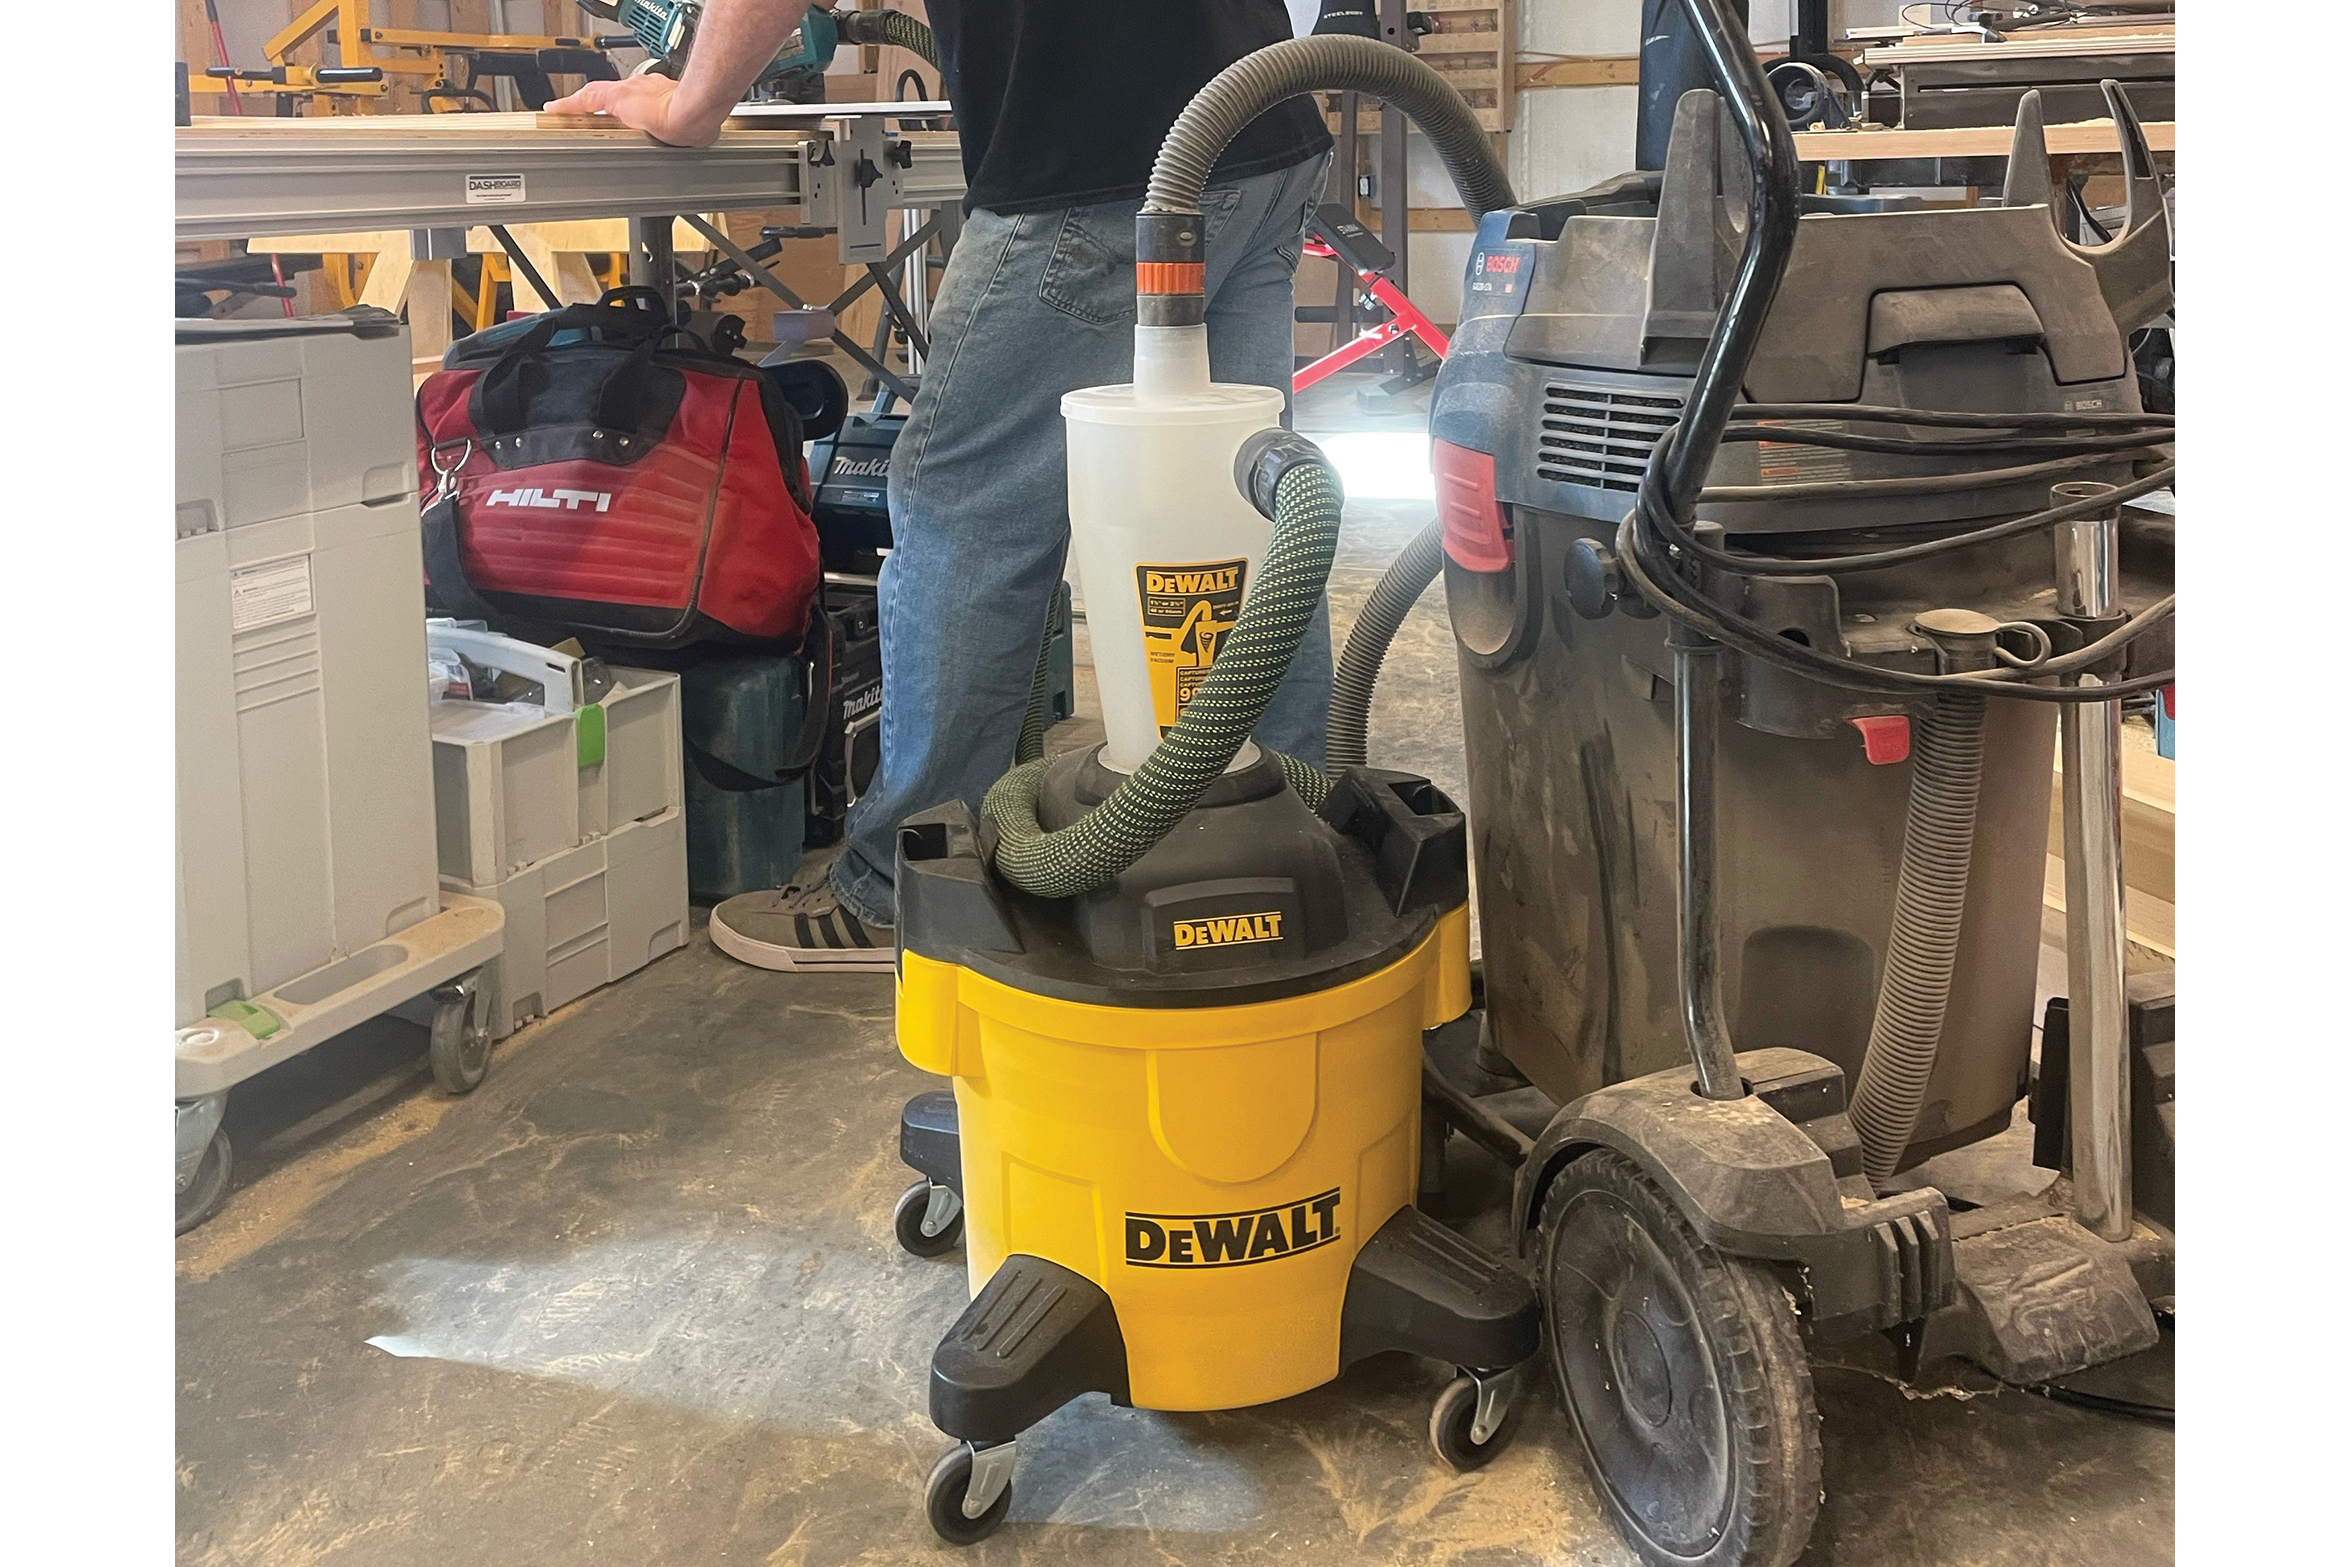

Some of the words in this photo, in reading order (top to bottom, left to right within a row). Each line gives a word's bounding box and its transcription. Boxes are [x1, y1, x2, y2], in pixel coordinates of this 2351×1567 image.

[1486, 255, 1520, 273] BOSCH
[834, 456, 890, 477] Maki
[486, 488, 612, 512] HILTI
[843, 685, 882, 719] Makit
